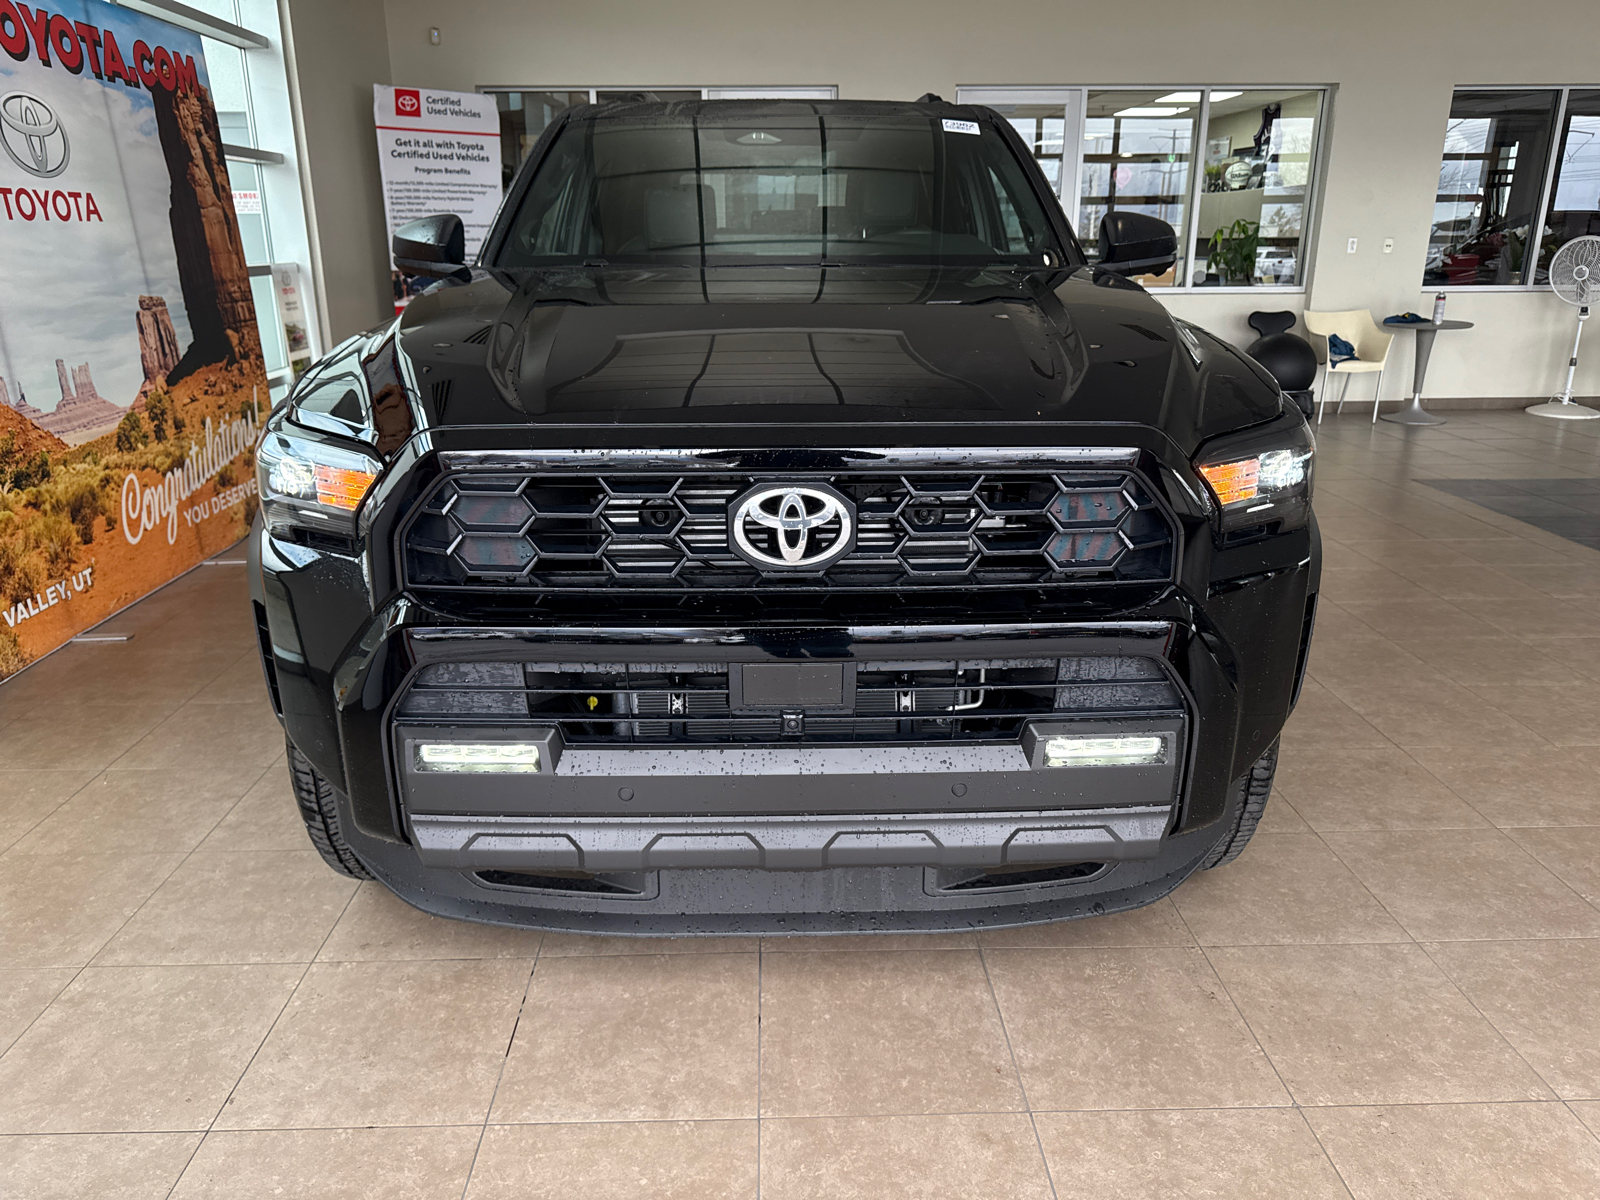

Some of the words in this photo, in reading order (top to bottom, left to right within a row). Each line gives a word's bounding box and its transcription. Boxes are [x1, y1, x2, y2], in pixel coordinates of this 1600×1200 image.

[426, 96, 461, 106] Certified
[427, 107, 447, 116] Used
[450, 108, 481, 118] Vehicles
[395, 138, 412, 147] Get
[413, 138, 421, 147] it
[422, 139, 433, 148] all
[435, 140, 455, 150] with
[456, 141, 484, 153] Toyota
[391, 150, 430, 159] Certified
[432, 152, 454, 161] Used
[455, 153, 490, 162] Vehicles
[414, 166, 443, 175] Program
[444, 167, 471, 175] Benefits
[0, 187, 103, 222] TOYOTA
[121, 385, 261, 545] Congratulations!
[183, 502, 209, 527] YOU
[211, 478, 258, 515] DESERVE
[2, 581, 71, 628] VALLEY,
[72, 567, 94, 593] UT
